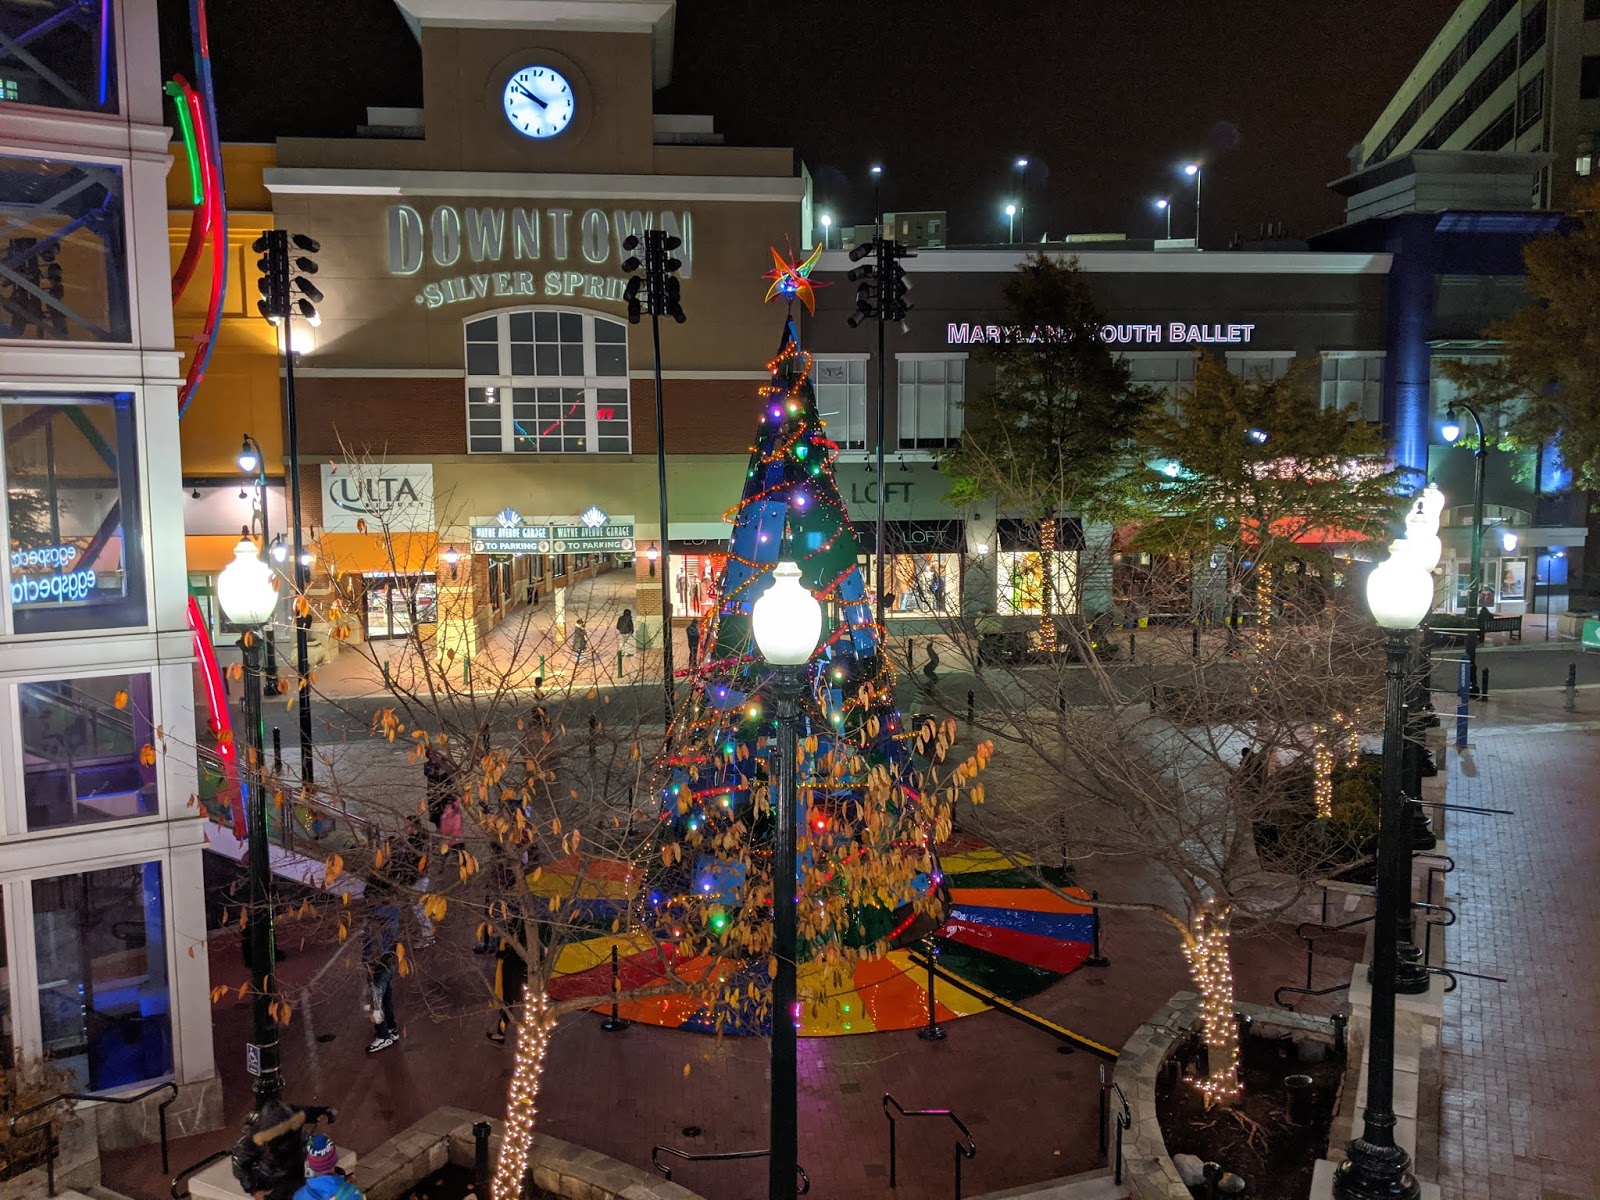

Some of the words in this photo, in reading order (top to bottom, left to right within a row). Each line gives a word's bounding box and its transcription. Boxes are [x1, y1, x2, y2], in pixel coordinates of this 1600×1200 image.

[387, 205, 692, 279] DOWNTOWN
[423, 271, 536, 309] SILVER
[544, 271, 647, 305] SPRIN
[1083, 323, 1162, 344] OUTH
[1168, 322, 1255, 343] BALLET
[340, 478, 419, 502] ULTA
[851, 481, 914, 503] LOFT
[557, 527, 579, 538] WAYNE
[581, 527, 604, 538] AVENUE
[606, 526, 630, 537] GARAGE
[902, 530, 947, 543] LOFT
[485, 542, 498, 550] TO
[500, 542, 538, 550] PARKING
[567, 542, 581, 550] TO
[582, 541, 621, 549] PARKING
